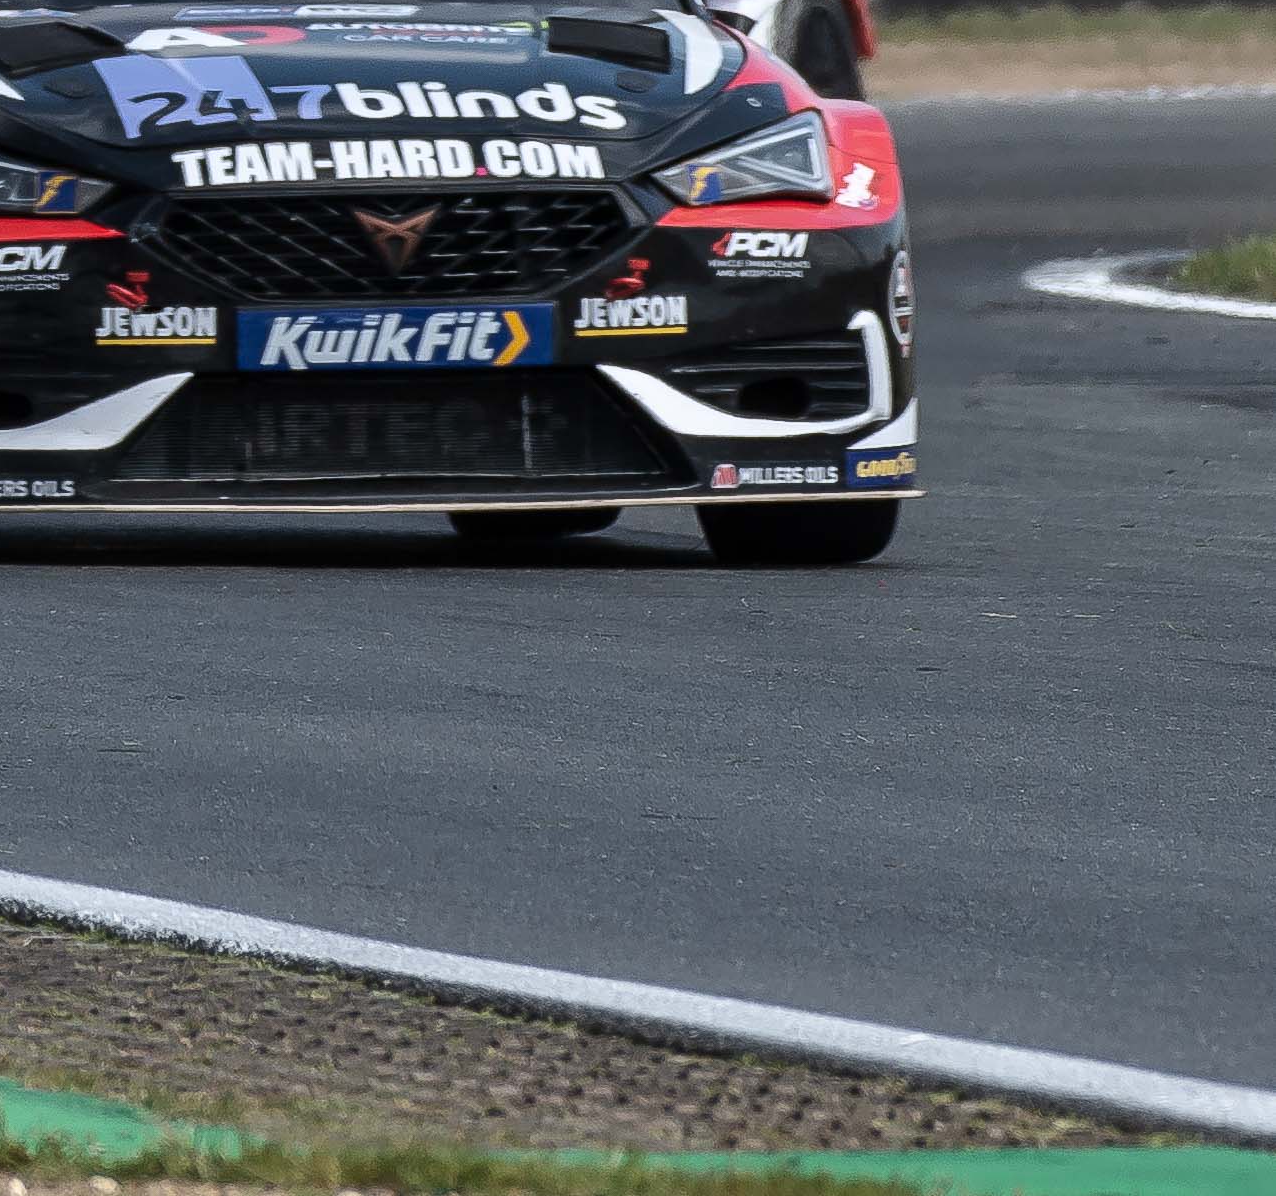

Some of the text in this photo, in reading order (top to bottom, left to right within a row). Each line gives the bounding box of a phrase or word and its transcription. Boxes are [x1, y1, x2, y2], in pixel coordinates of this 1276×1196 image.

[171, 139, 607, 188] TEAM-HARD.COM
[95, 306, 218, 338] JEWSON
[574, 295, 688, 330] JEWSON
[260, 310, 502, 370] KwikFit
[30, 480, 76, 497] OILS
[738, 465, 839, 484] MILLERS OILS
